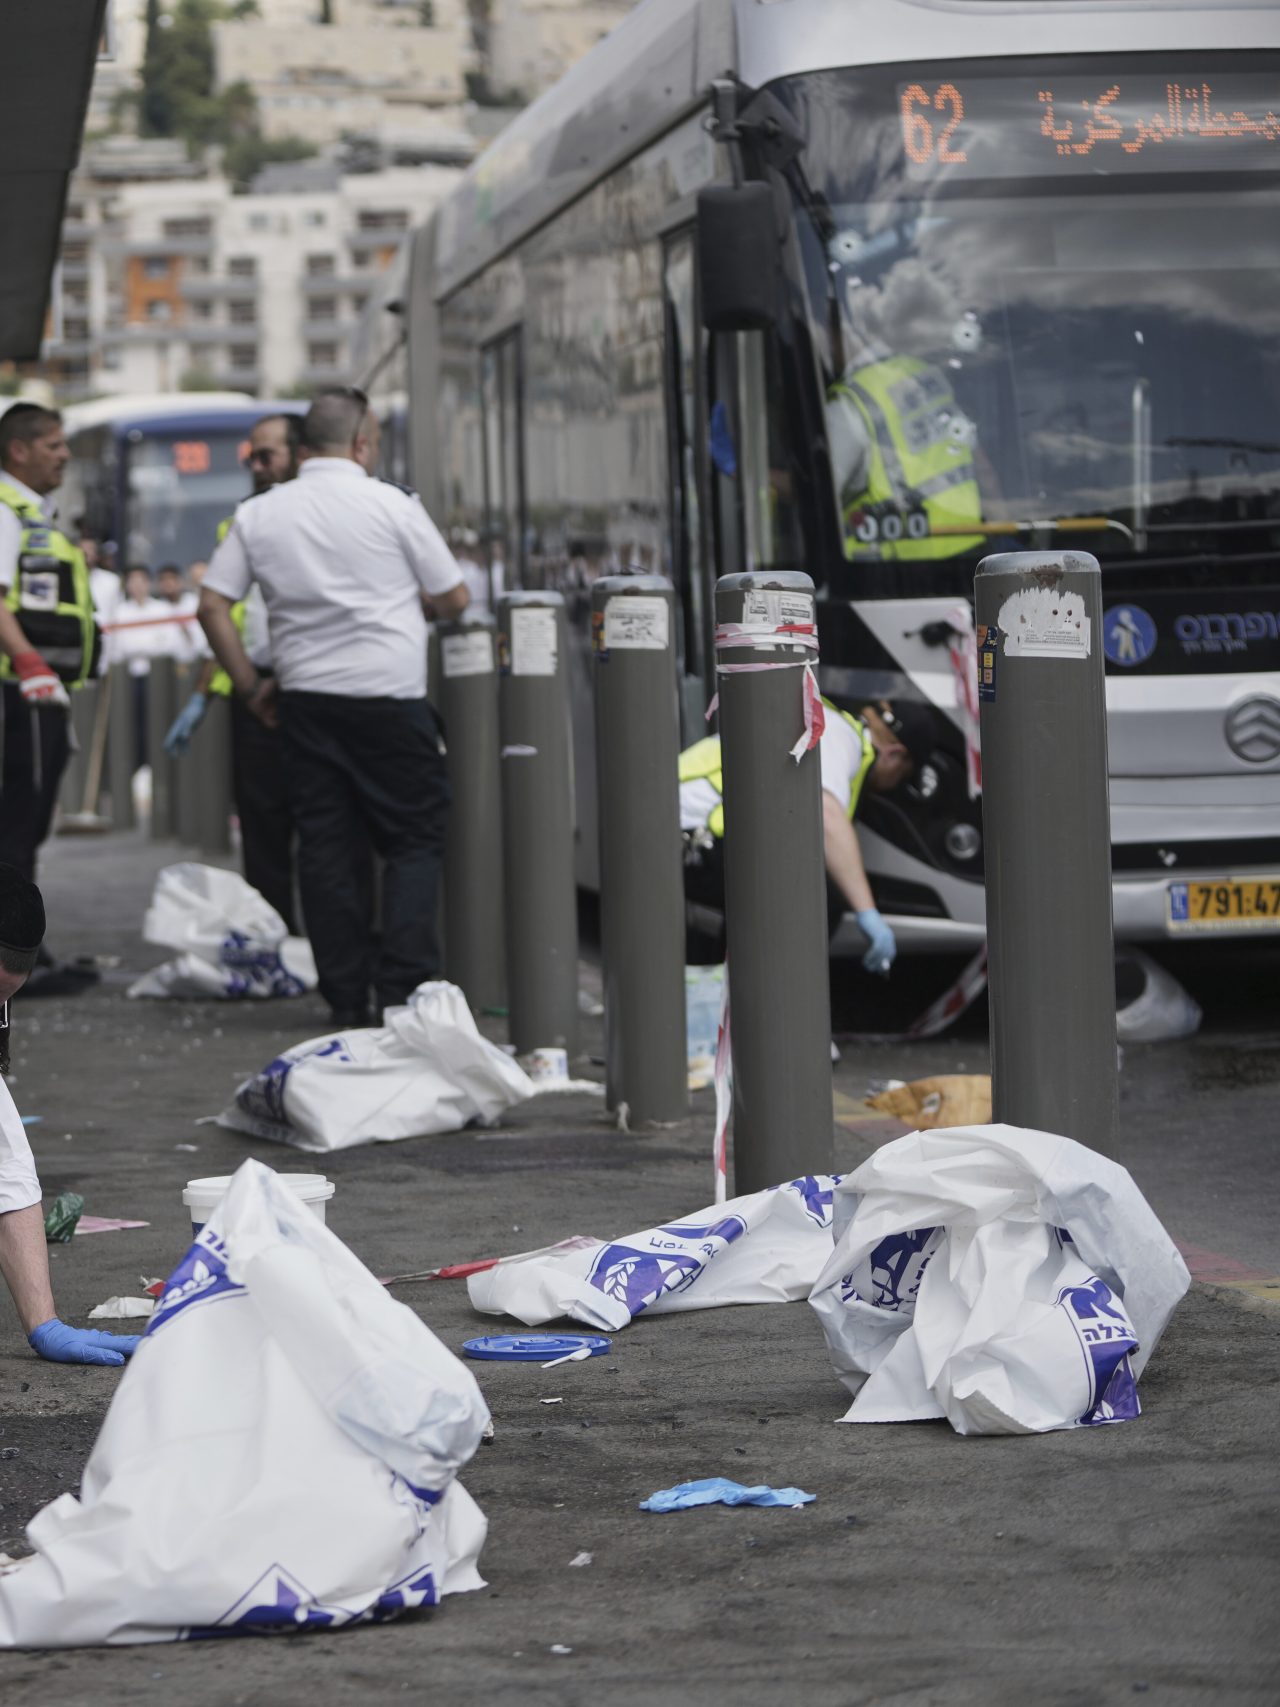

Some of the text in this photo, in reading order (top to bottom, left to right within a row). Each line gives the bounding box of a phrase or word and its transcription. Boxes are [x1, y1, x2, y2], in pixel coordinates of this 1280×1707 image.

[900, 83, 967, 164] 62
[1037, 83, 1184, 155] المركزية
[1174, 611, 1280, 642] ופרבוס
[1082, 1323, 1137, 1342] צלה
